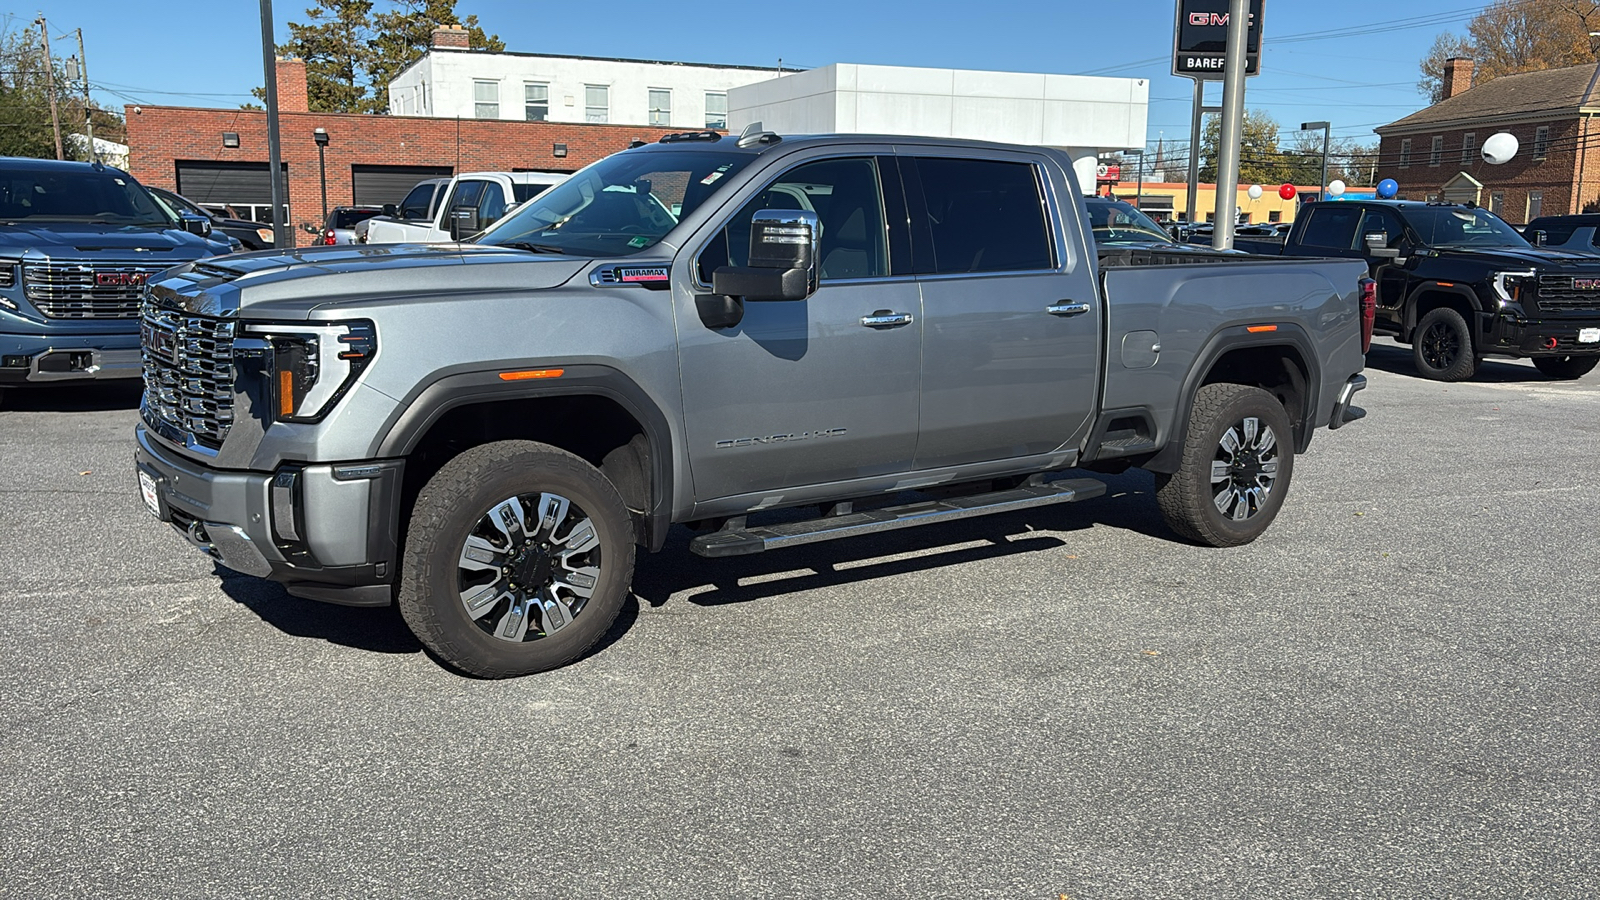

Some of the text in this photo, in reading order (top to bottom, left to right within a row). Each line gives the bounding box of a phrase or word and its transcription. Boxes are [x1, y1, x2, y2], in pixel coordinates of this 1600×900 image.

[1187, 58, 1248, 68] BAREF
[624, 269, 665, 277] DURAMAX
[97, 273, 152, 285] GM
[716, 428, 846, 449] DENALI HD
